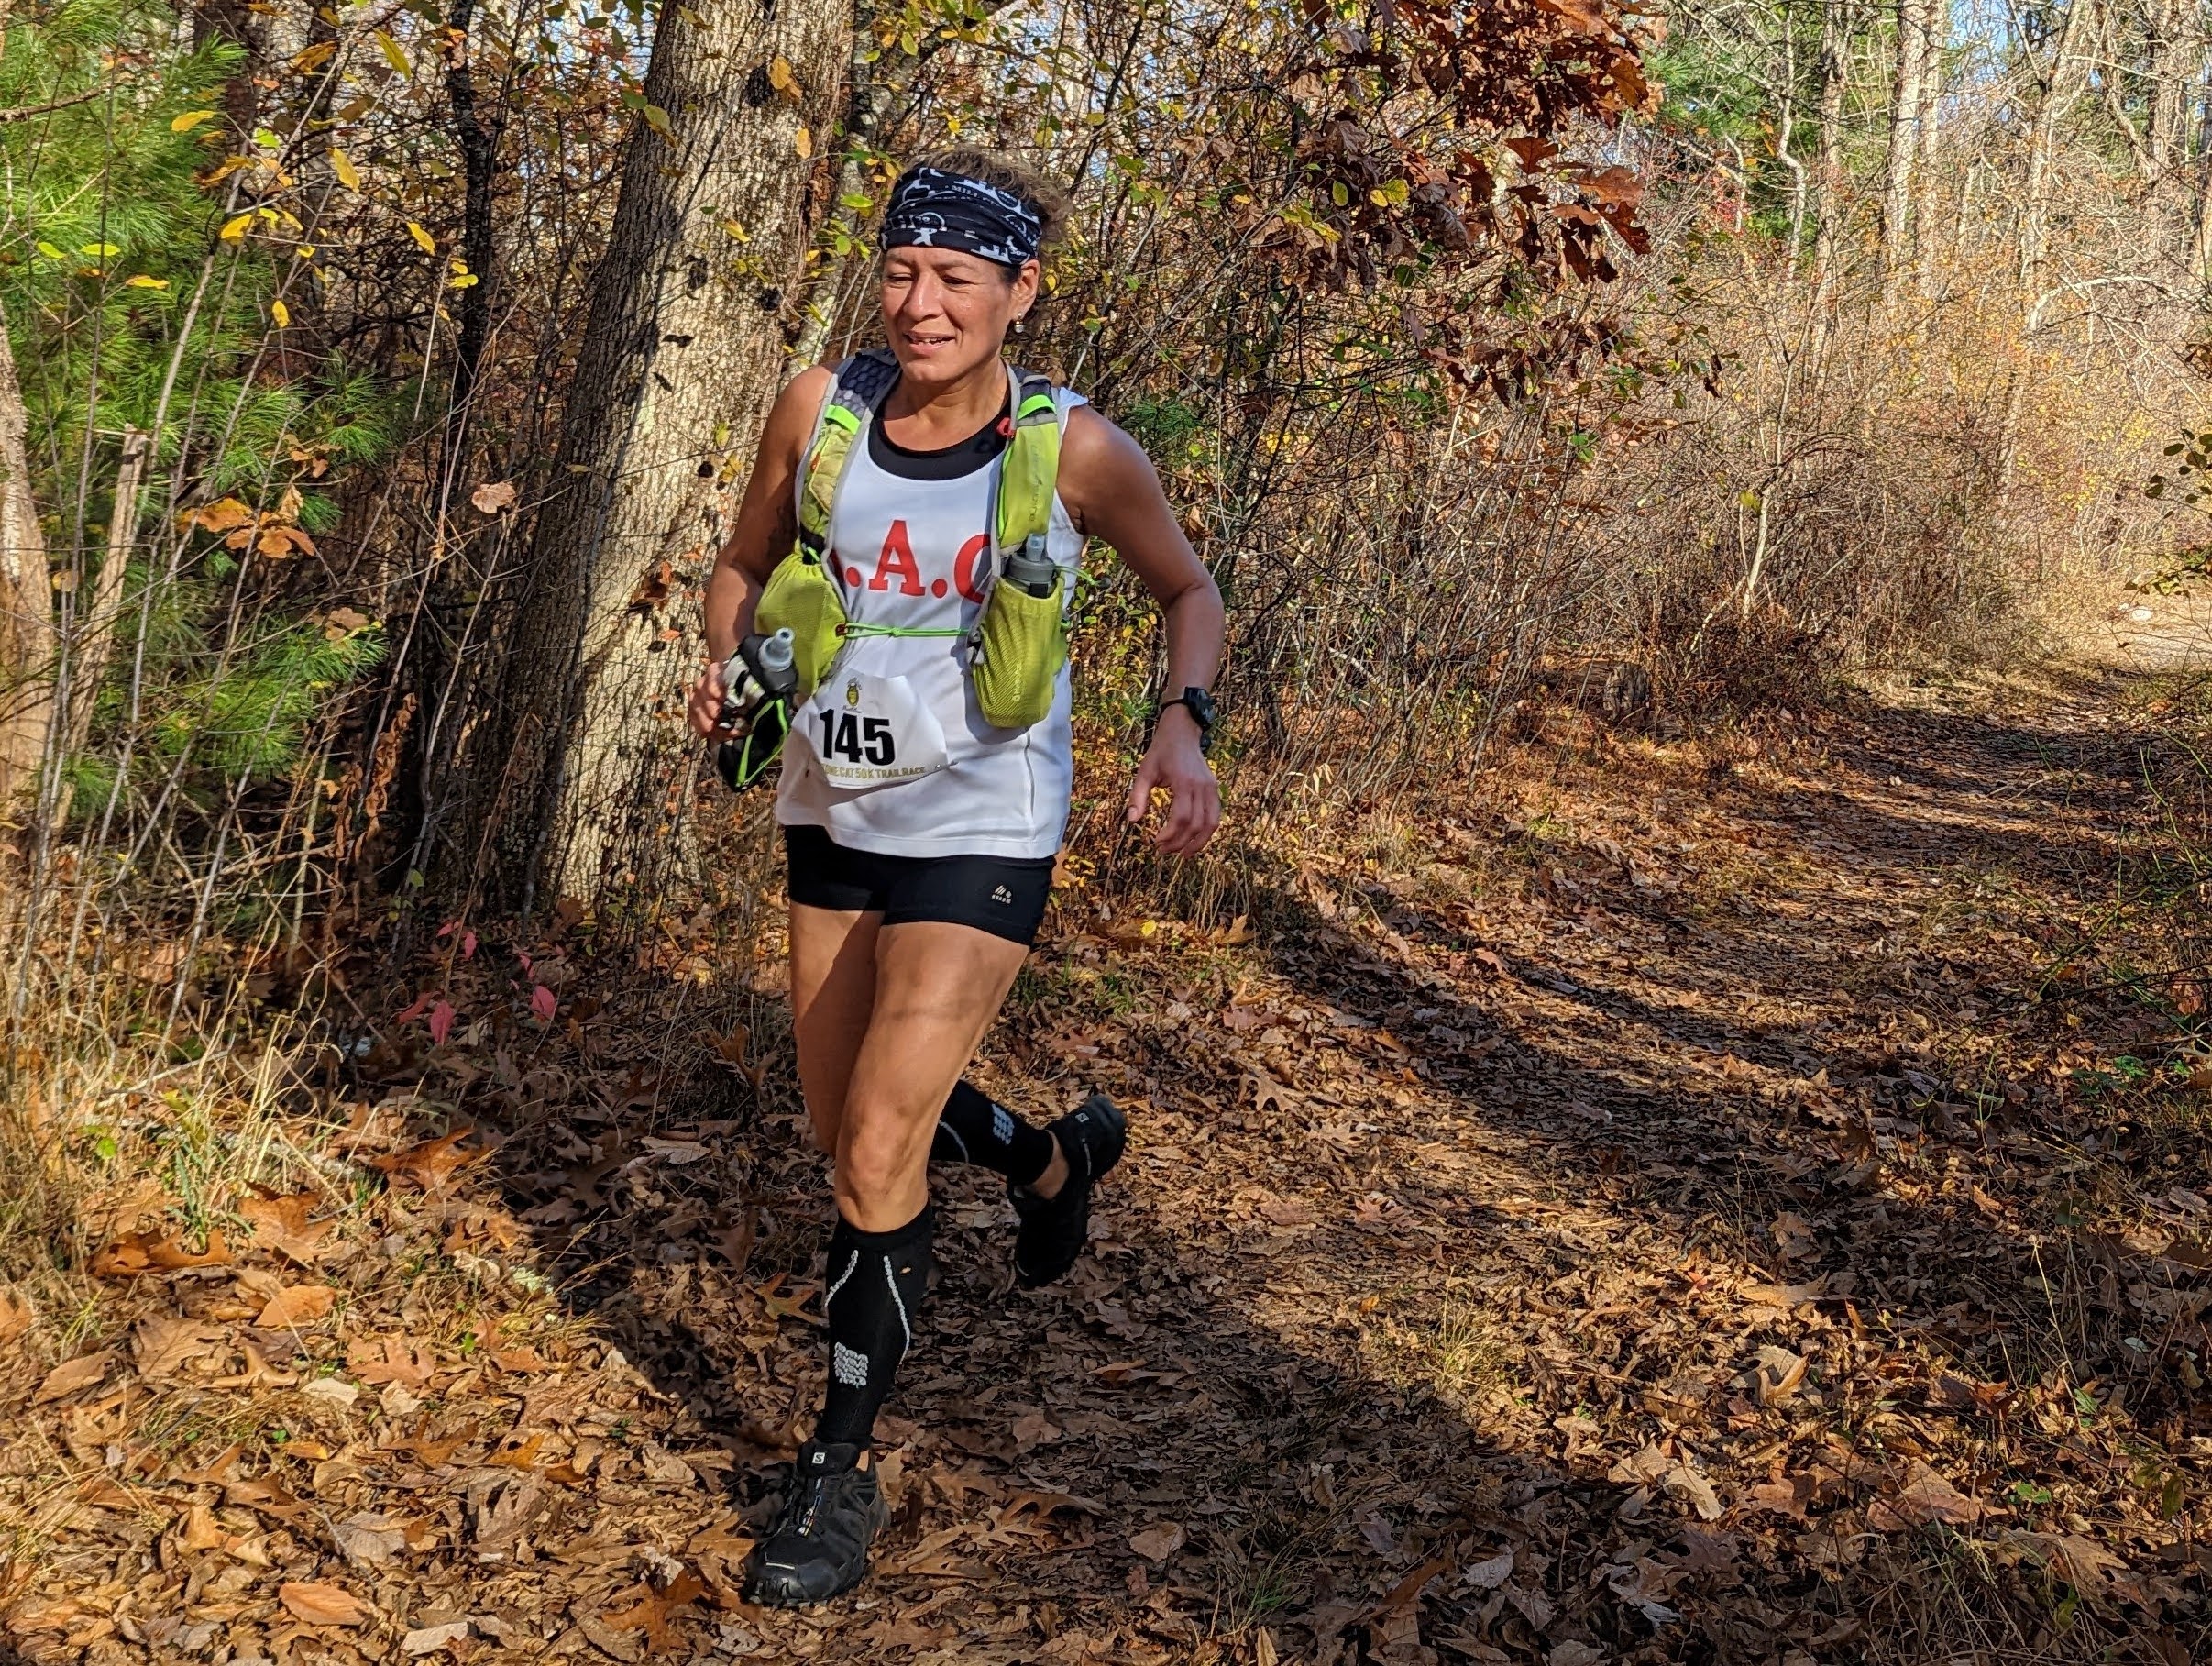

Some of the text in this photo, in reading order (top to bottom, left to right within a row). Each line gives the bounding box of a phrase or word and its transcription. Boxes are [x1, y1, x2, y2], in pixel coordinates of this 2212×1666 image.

[820, 708, 896, 766] 145
[875, 768, 901, 778] TRAIL
[901, 767, 926, 776] RACE
